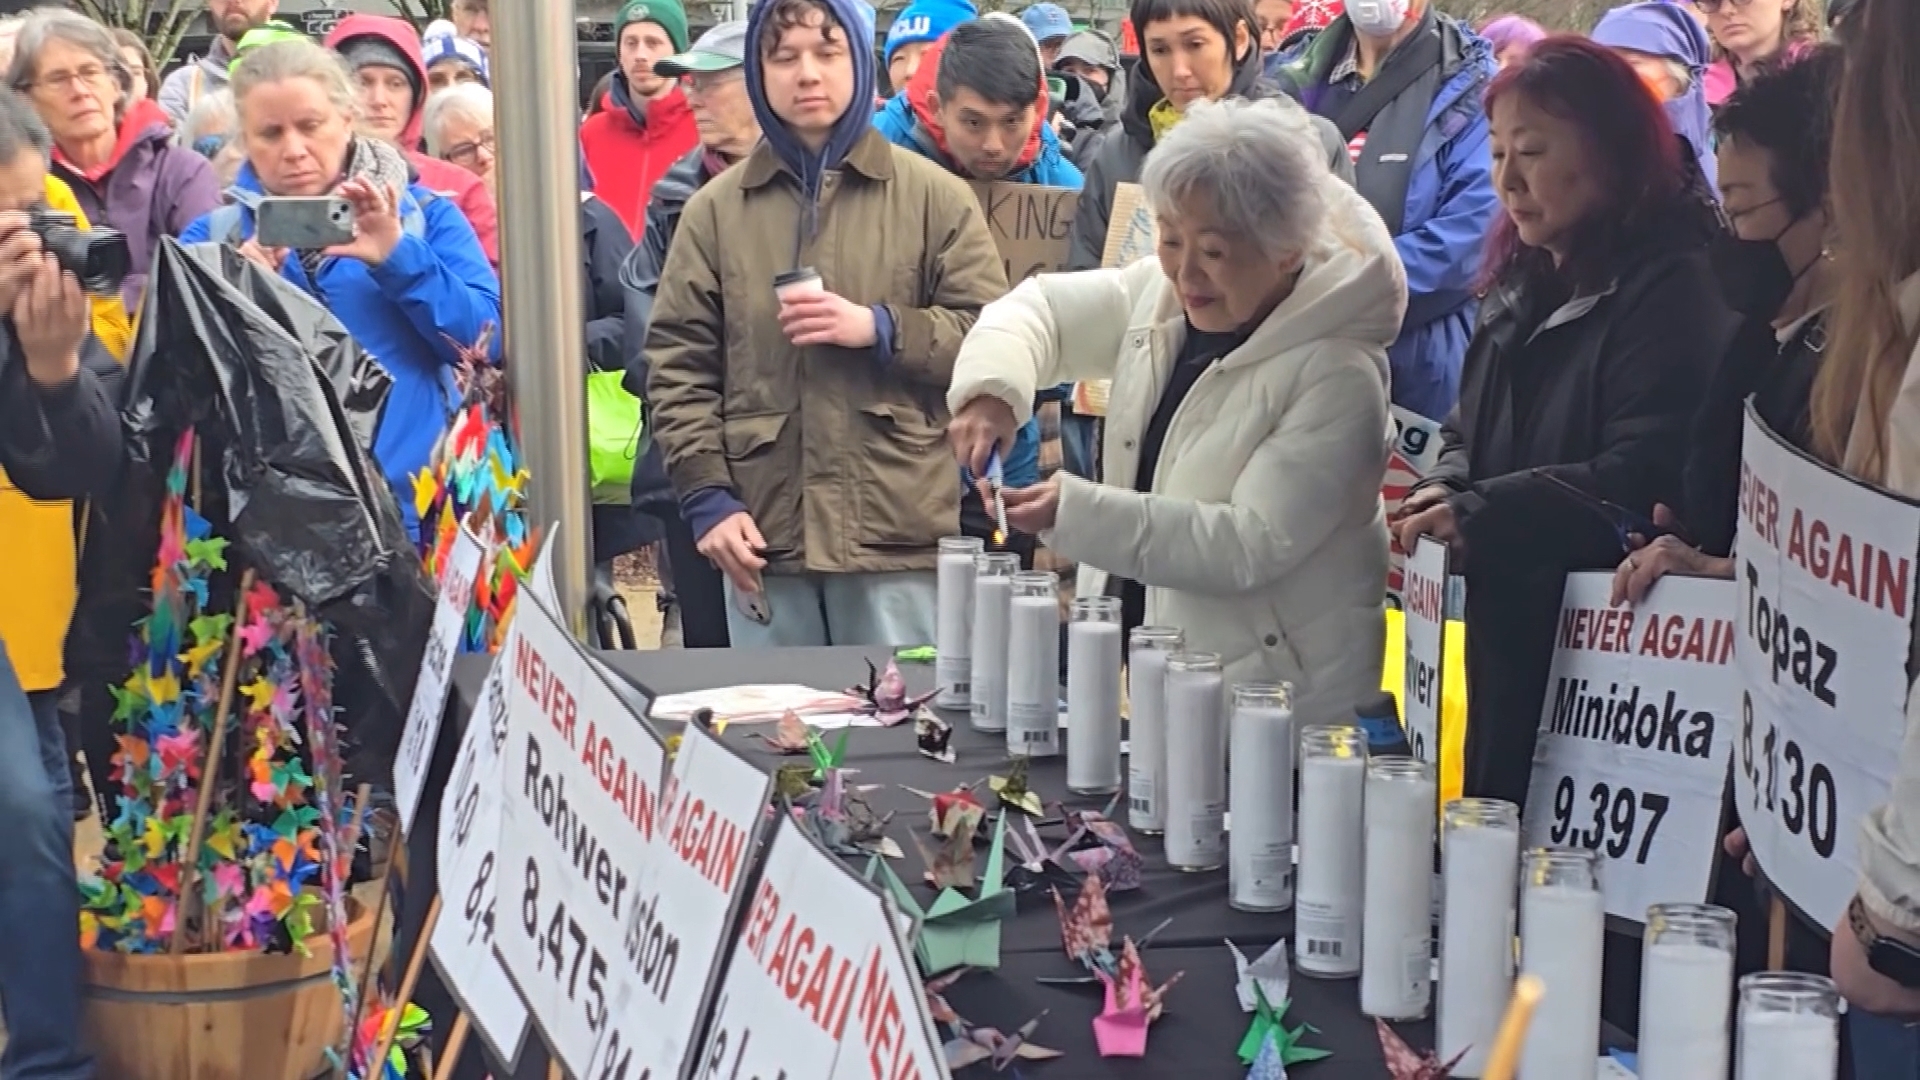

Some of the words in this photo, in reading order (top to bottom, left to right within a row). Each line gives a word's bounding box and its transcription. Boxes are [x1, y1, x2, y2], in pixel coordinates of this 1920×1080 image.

[986, 187, 1075, 241] KING
[1787, 507, 1910, 618] AGAIN
[1558, 608, 1635, 654] NEVER
[1746, 558, 1837, 708] Topaz
[515, 632, 577, 751] NEVER
[582, 720, 657, 842] AGAIN
[1549, 677, 1715, 758] Minidoka
[1742, 690, 1837, 859] 8,130
[524, 732, 627, 921] Rohwer
[669, 791, 746, 895] AGAIN
[522, 856, 608, 1033] 8,475
